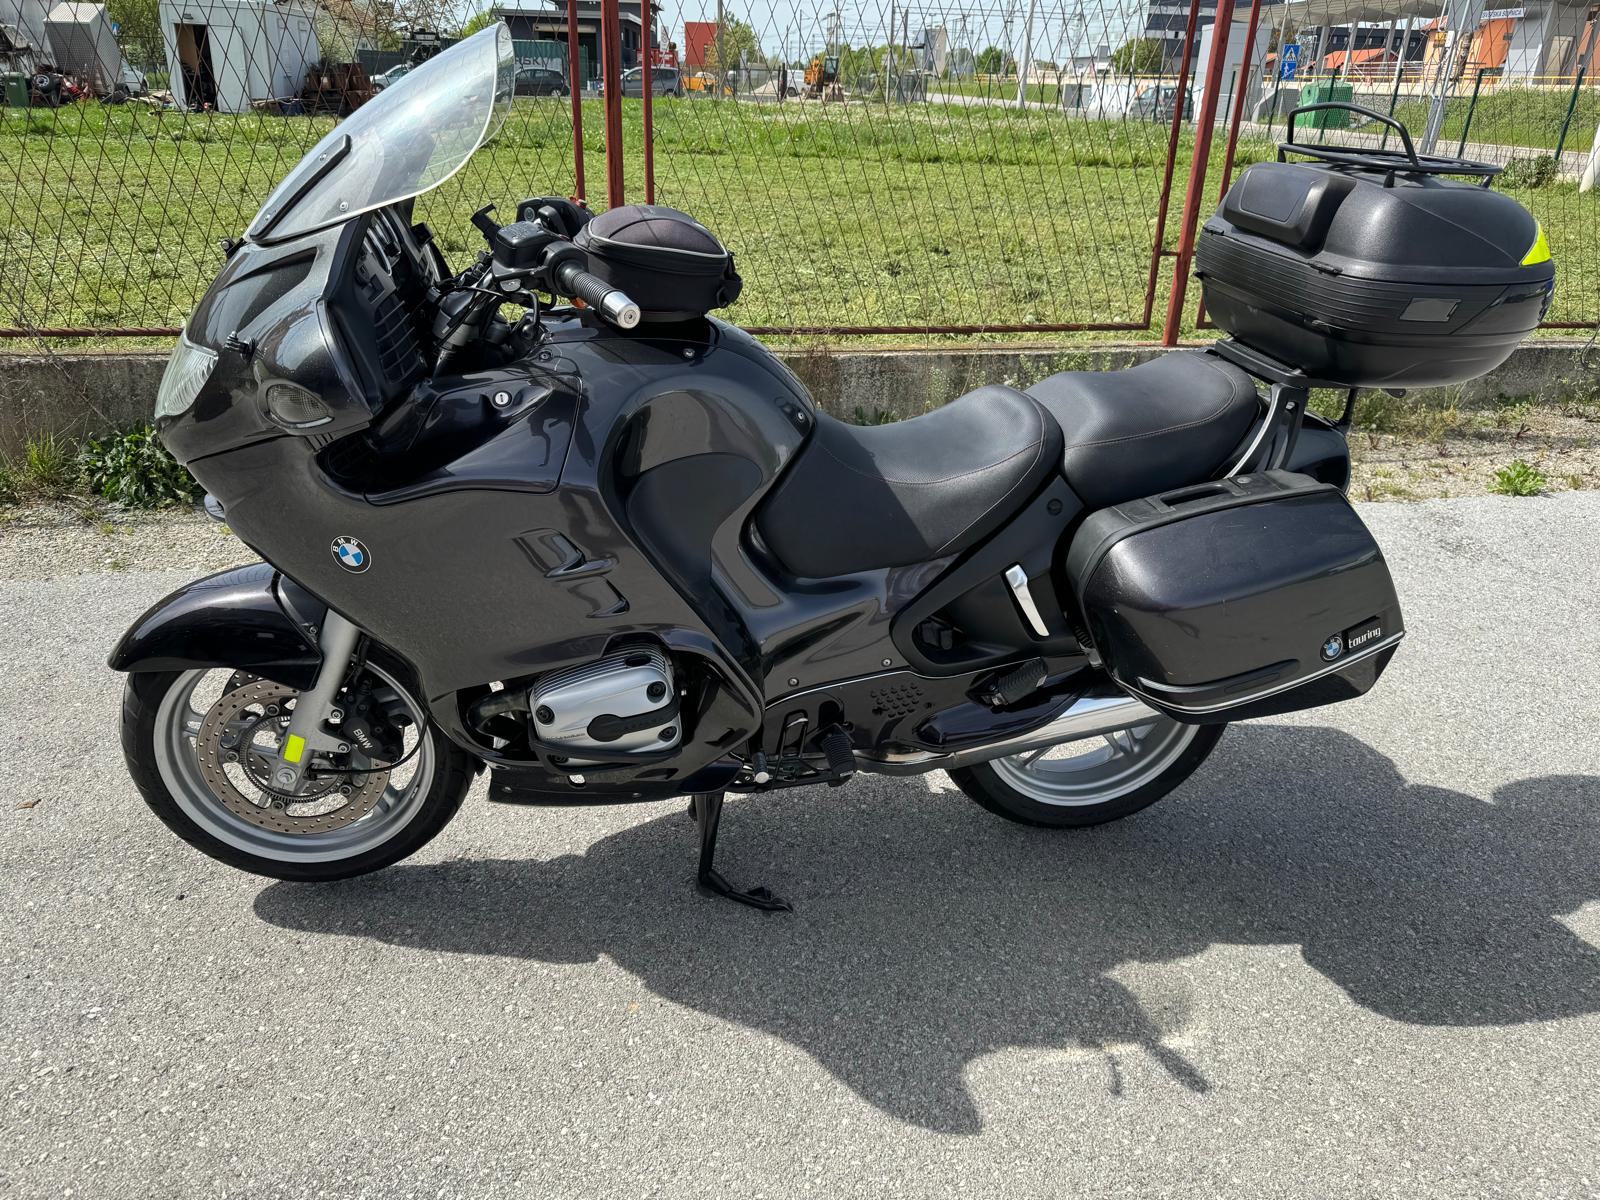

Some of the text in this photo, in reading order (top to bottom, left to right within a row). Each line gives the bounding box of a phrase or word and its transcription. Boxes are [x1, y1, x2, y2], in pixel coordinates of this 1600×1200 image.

[333, 538, 358, 552] BMW
[1348, 627, 1381, 649] touring
[353, 728, 373, 749] BMW
